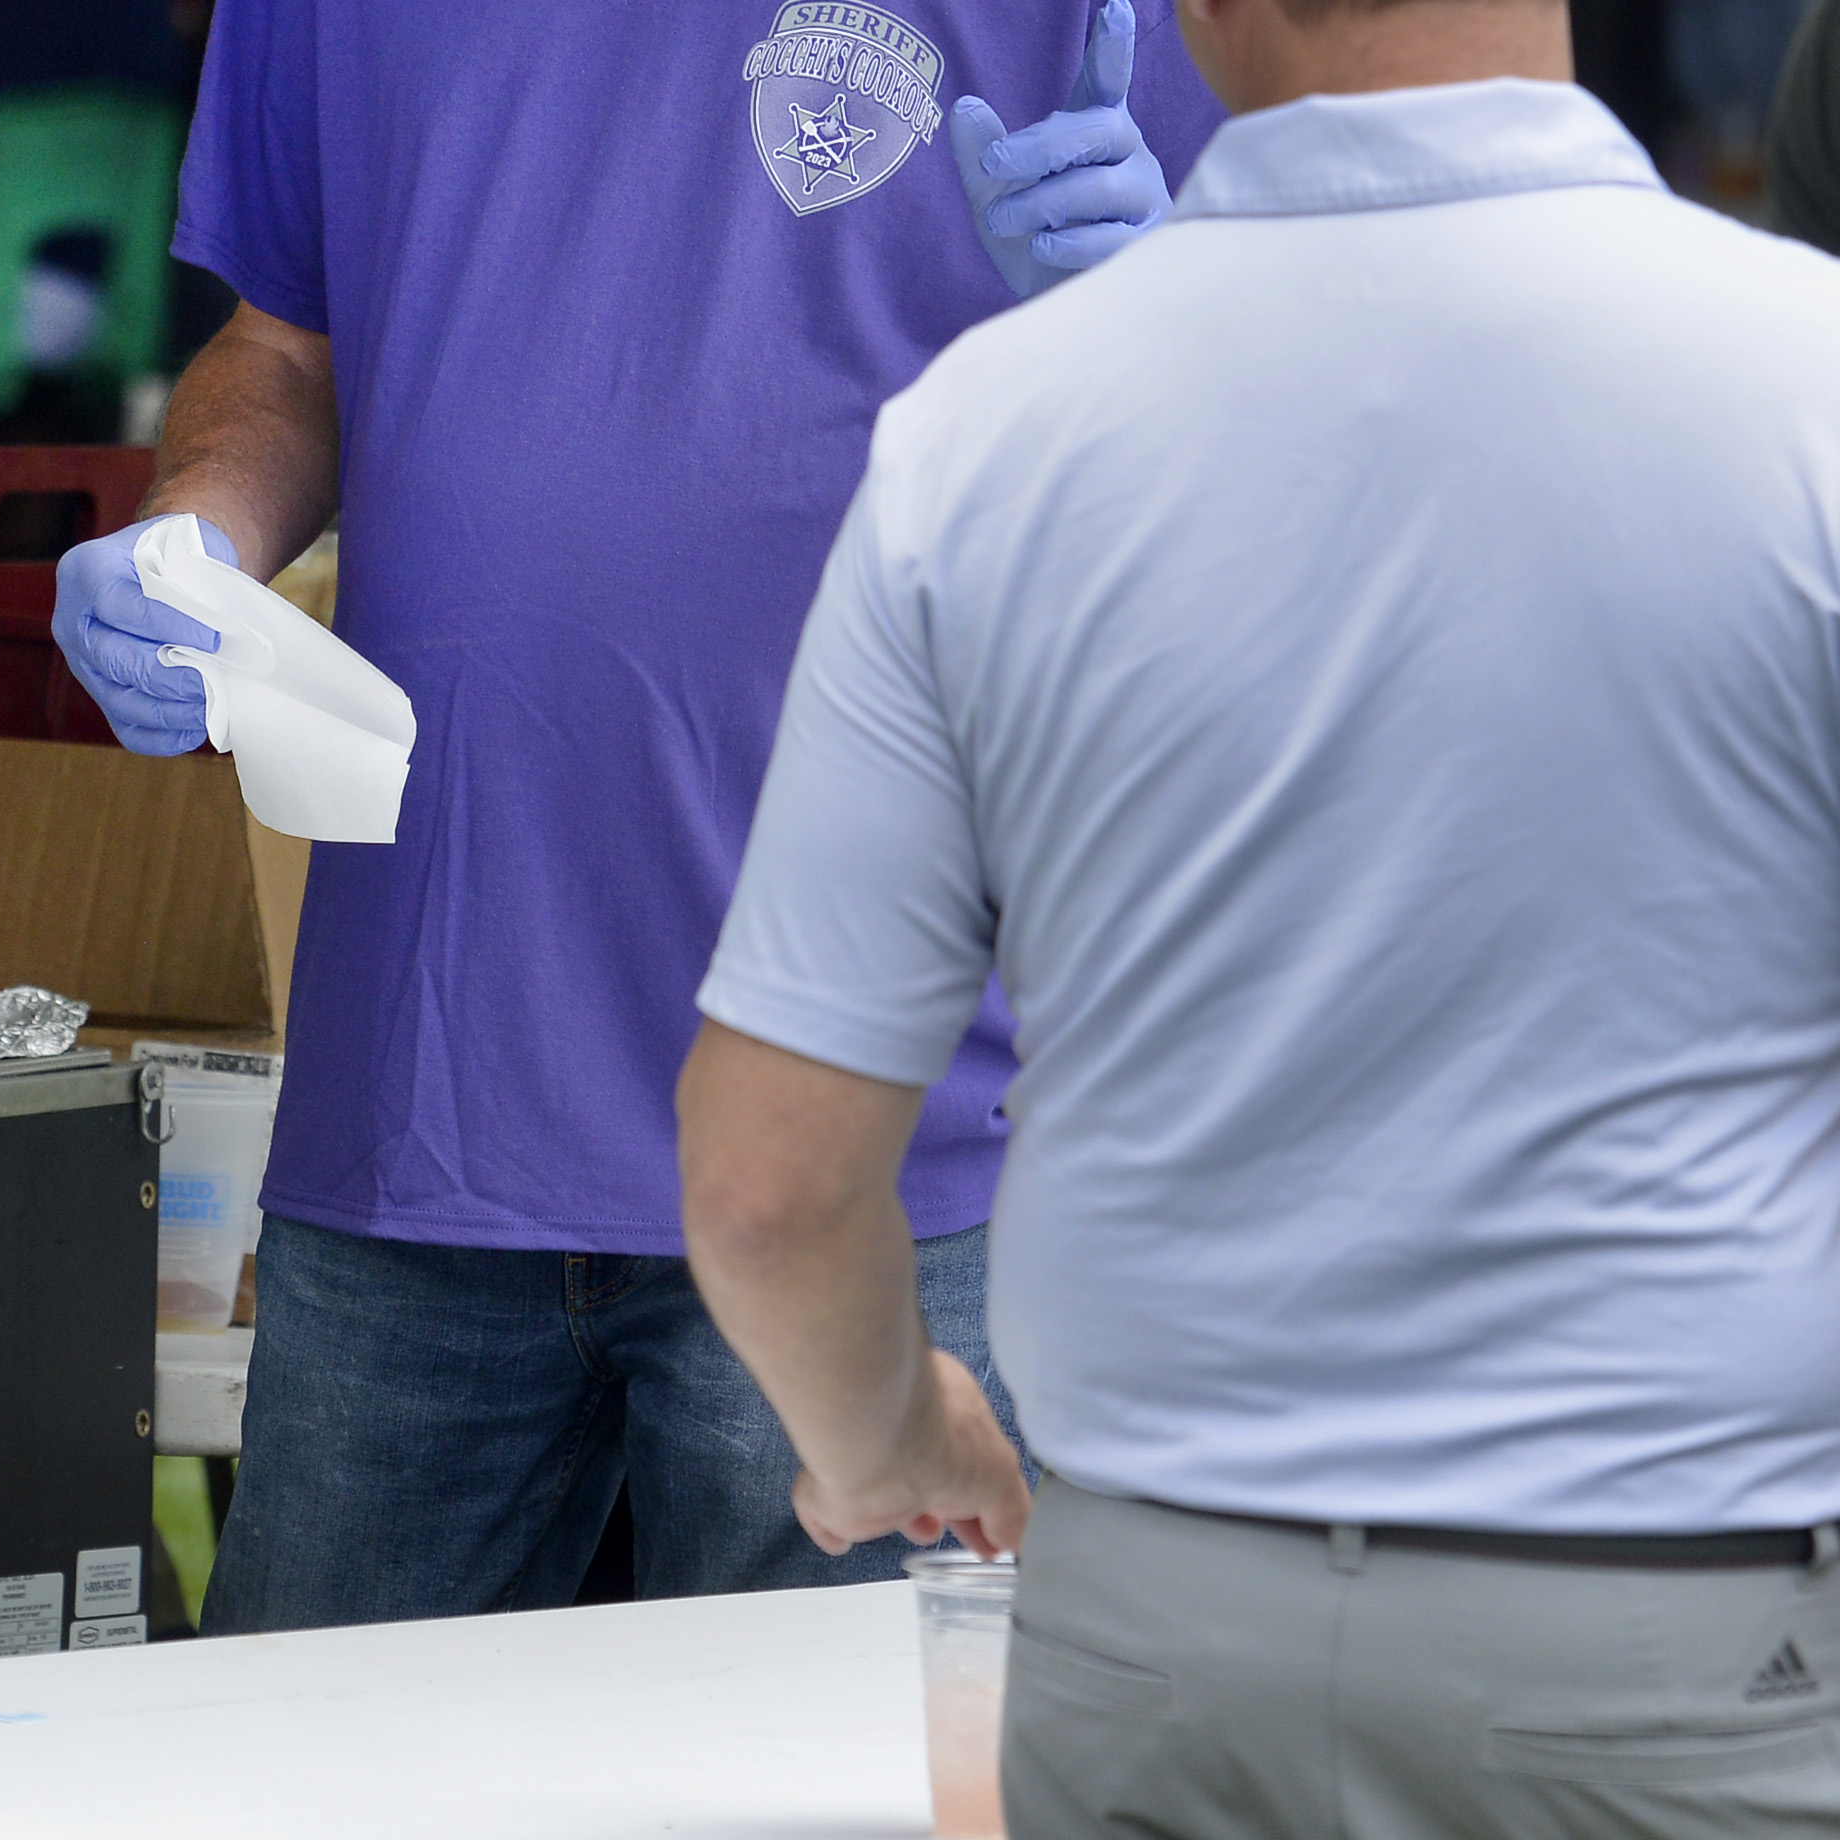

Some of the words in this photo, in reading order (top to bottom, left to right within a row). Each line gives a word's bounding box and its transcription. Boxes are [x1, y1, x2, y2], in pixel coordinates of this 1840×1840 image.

[793, 5, 929, 67] SHERIFF
[744, 34, 852, 84] COCCHI'S
[847, 44, 943, 145] COOKOUT
[805, 151, 831, 168] 2023
[159, 1180, 215, 1199] BUD
[159, 1201, 223, 1220] IGHT
